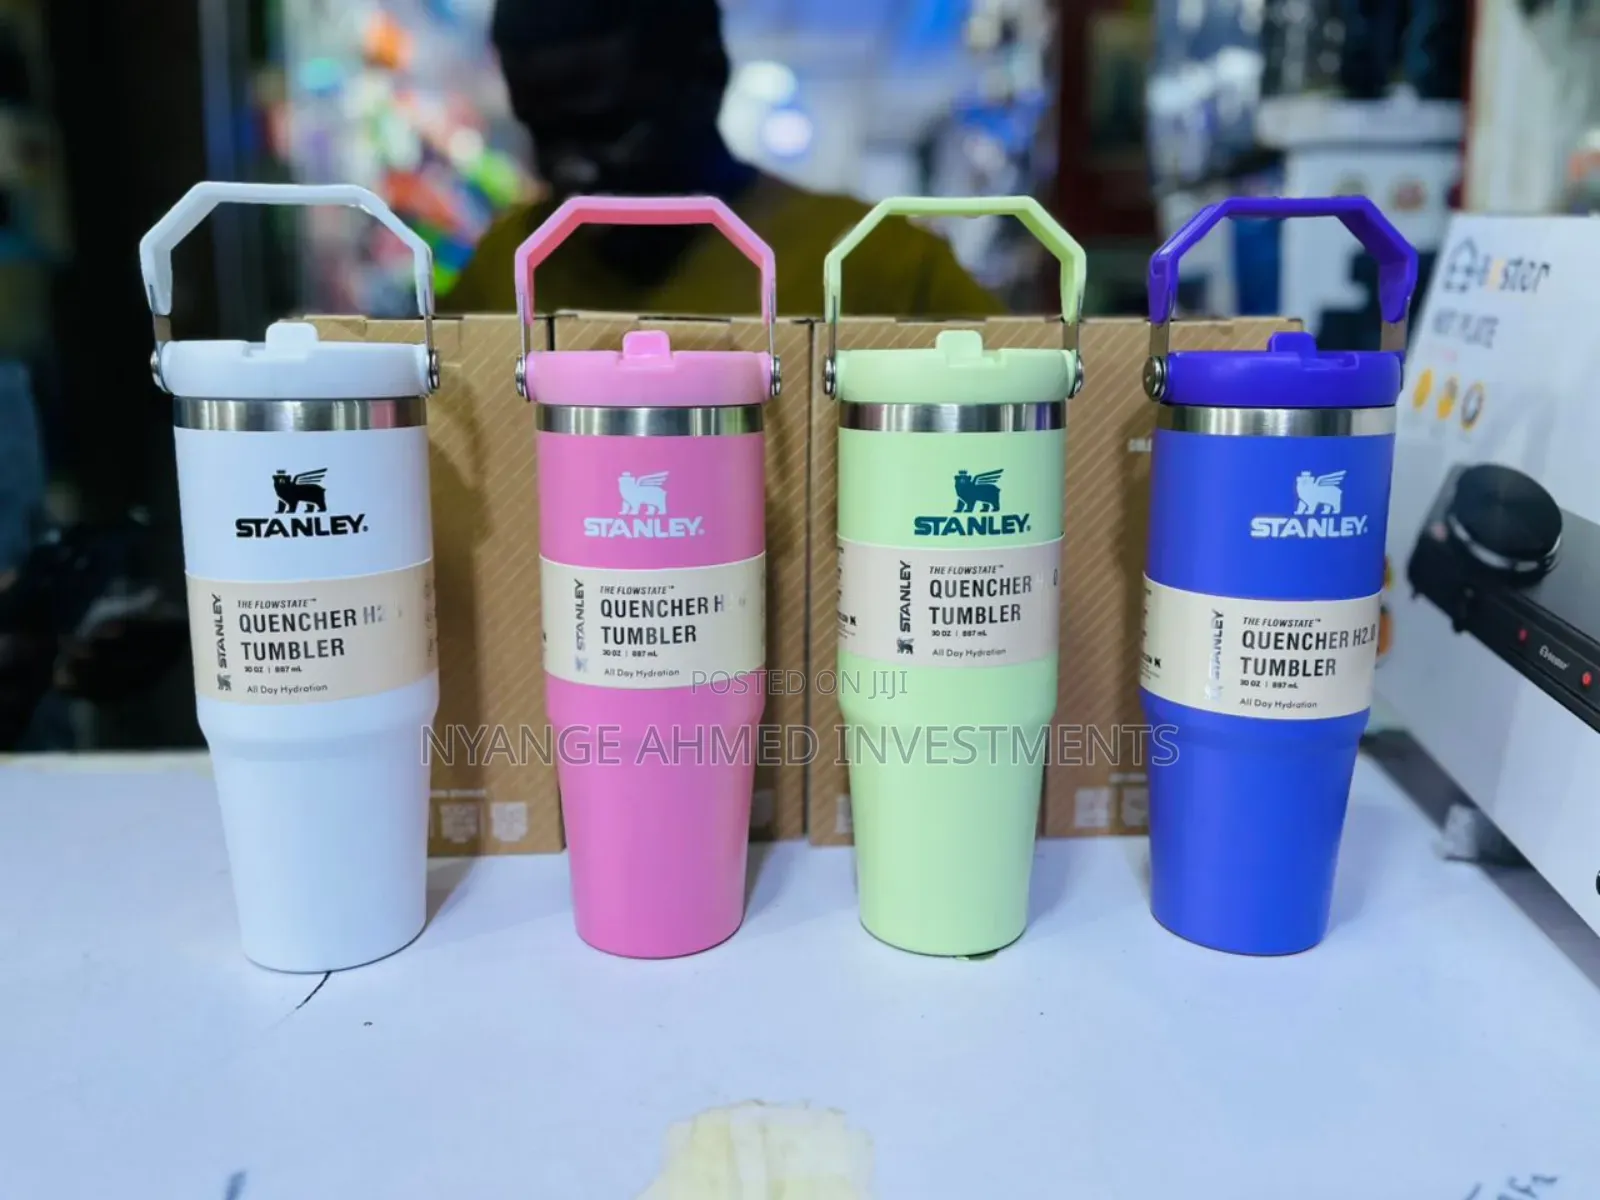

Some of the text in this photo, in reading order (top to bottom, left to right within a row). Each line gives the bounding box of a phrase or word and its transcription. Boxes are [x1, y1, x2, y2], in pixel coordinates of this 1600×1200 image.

[929, 566, 945, 575] THE
[600, 586, 614, 595] THE
[900, 560, 911, 632] STANLEY
[929, 575, 1032, 599] QUENCHER
[237, 600, 252, 609] THE
[574, 578, 585, 651] STANLEY
[600, 596, 709, 618] QUENCHER
[928, 603, 1021, 625] TUMBLER
[212, 593, 228, 669] STANLEY
[239, 608, 357, 634] QUENCHER
[1243, 617, 1259, 626] THE
[600, 624, 697, 645] TUMBLER
[1242, 623, 1376, 651] QUENCHER H2.0
[240, 638, 345, 661] TUMBLER
[946, 649, 964, 658] Day
[965, 648, 1006, 658] Hydration
[244, 665, 253, 673] 30
[604, 668, 680, 679] All Day Hydration
[1240, 656, 1336, 677] TUMBLER
[247, 683, 328, 695] All Day Hydration
[1240, 679, 1249, 687] 30
[1239, 698, 1318, 709] All Day Hydration
